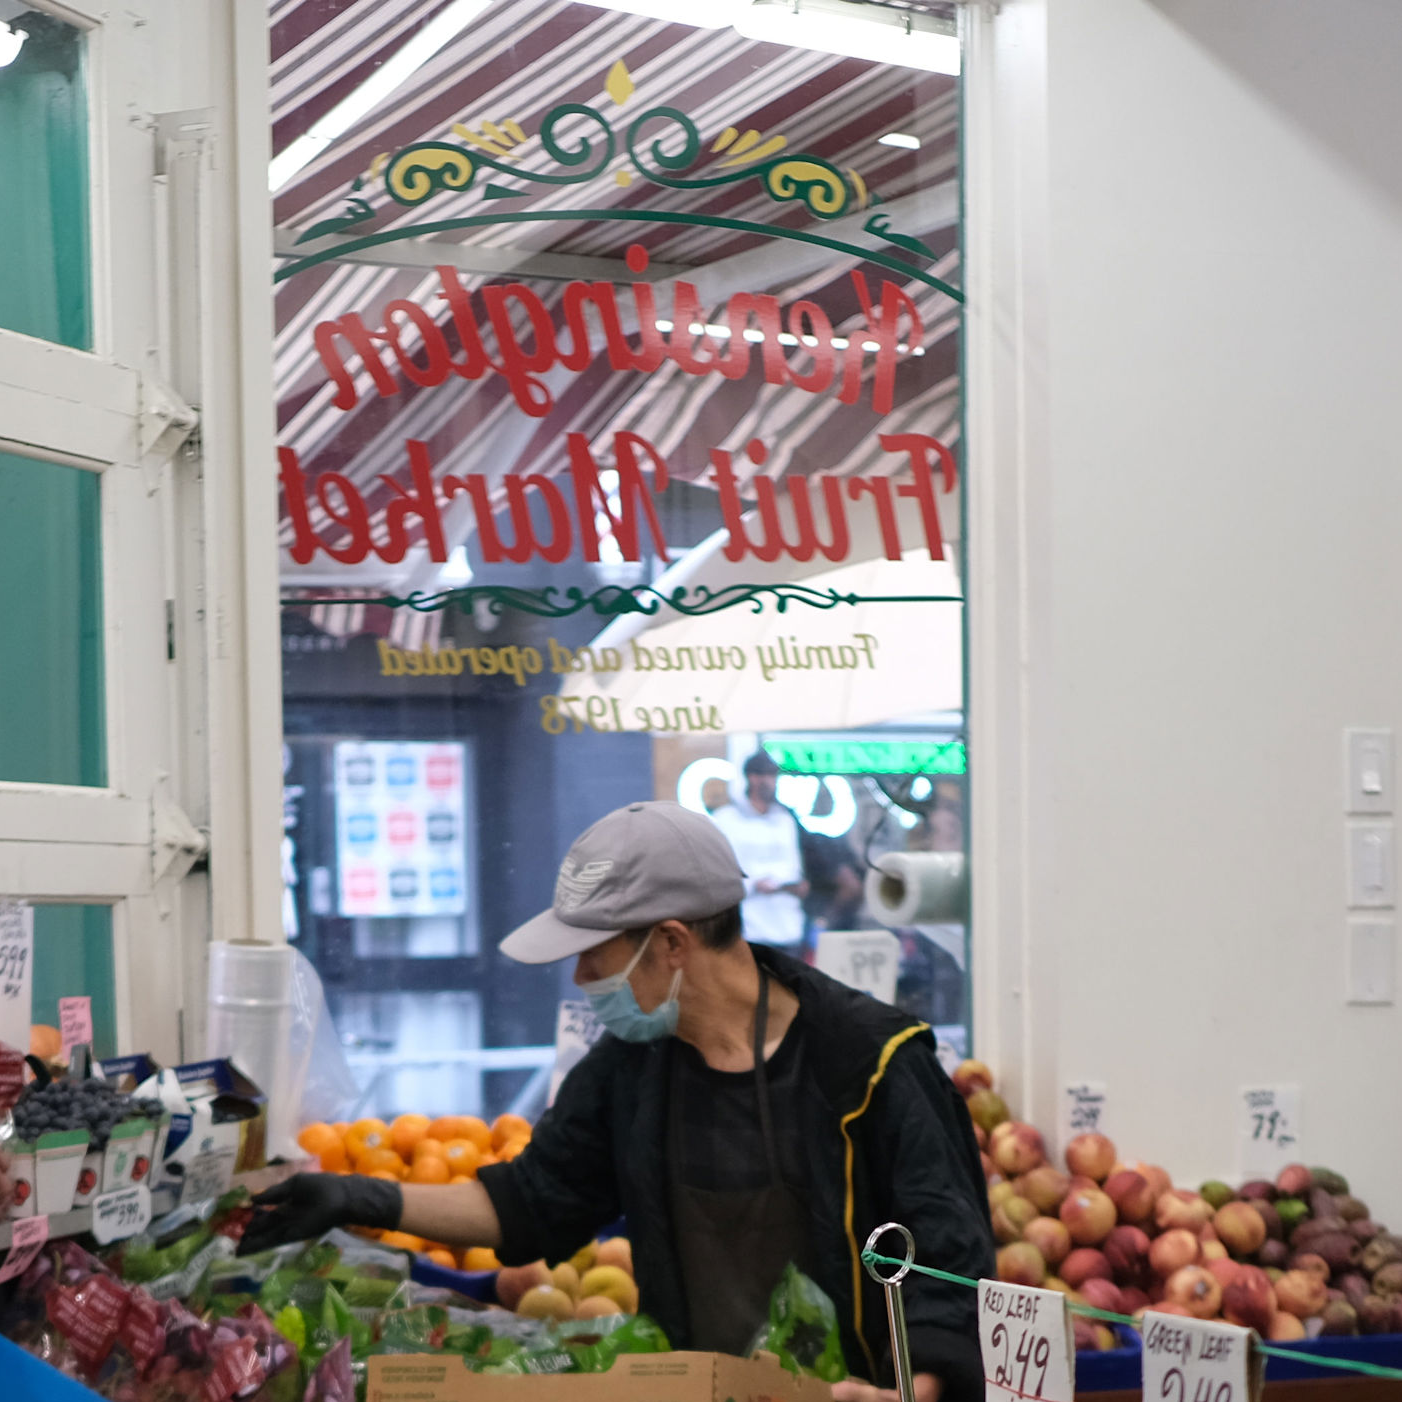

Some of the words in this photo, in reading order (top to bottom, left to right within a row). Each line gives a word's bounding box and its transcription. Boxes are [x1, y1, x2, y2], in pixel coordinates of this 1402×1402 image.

[983, 1287, 1005, 1314] RED
[1006, 1293, 1042, 1324] LEAF
[1147, 1320, 1192, 1366] GREEN
[1199, 1332, 1236, 1362] LEAF
